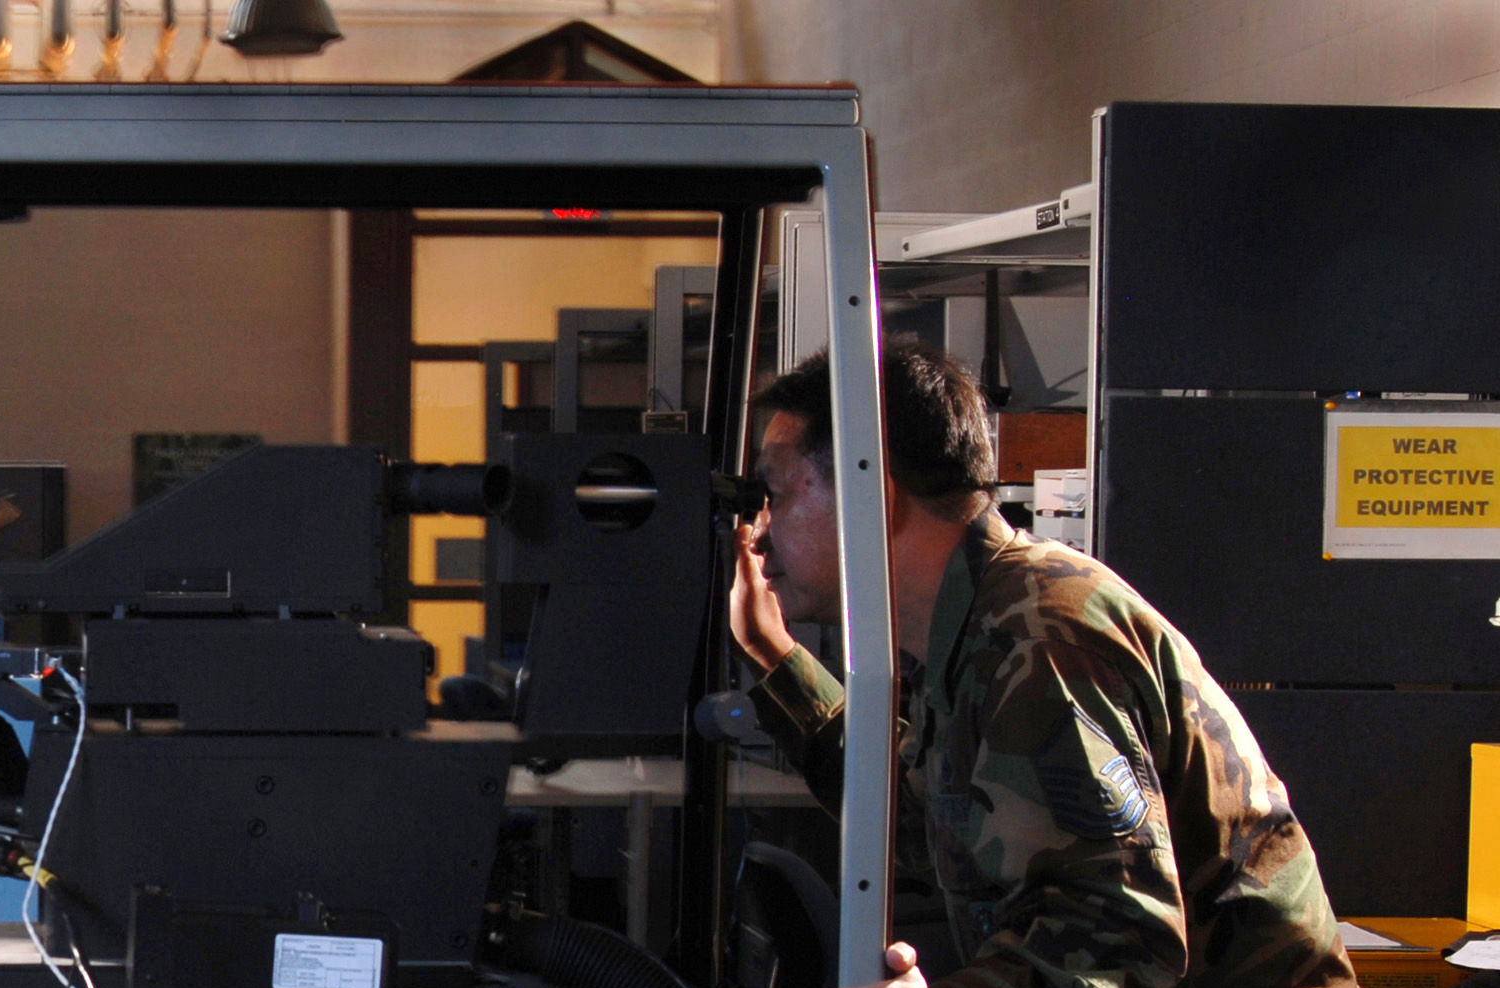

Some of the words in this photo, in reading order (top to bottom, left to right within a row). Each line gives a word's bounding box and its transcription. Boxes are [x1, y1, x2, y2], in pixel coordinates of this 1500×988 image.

[1392, 438, 1457, 454] WEAR
[1353, 469, 1494, 485] PROTECTIVE
[1357, 500, 1489, 516] EQUIPMENT
